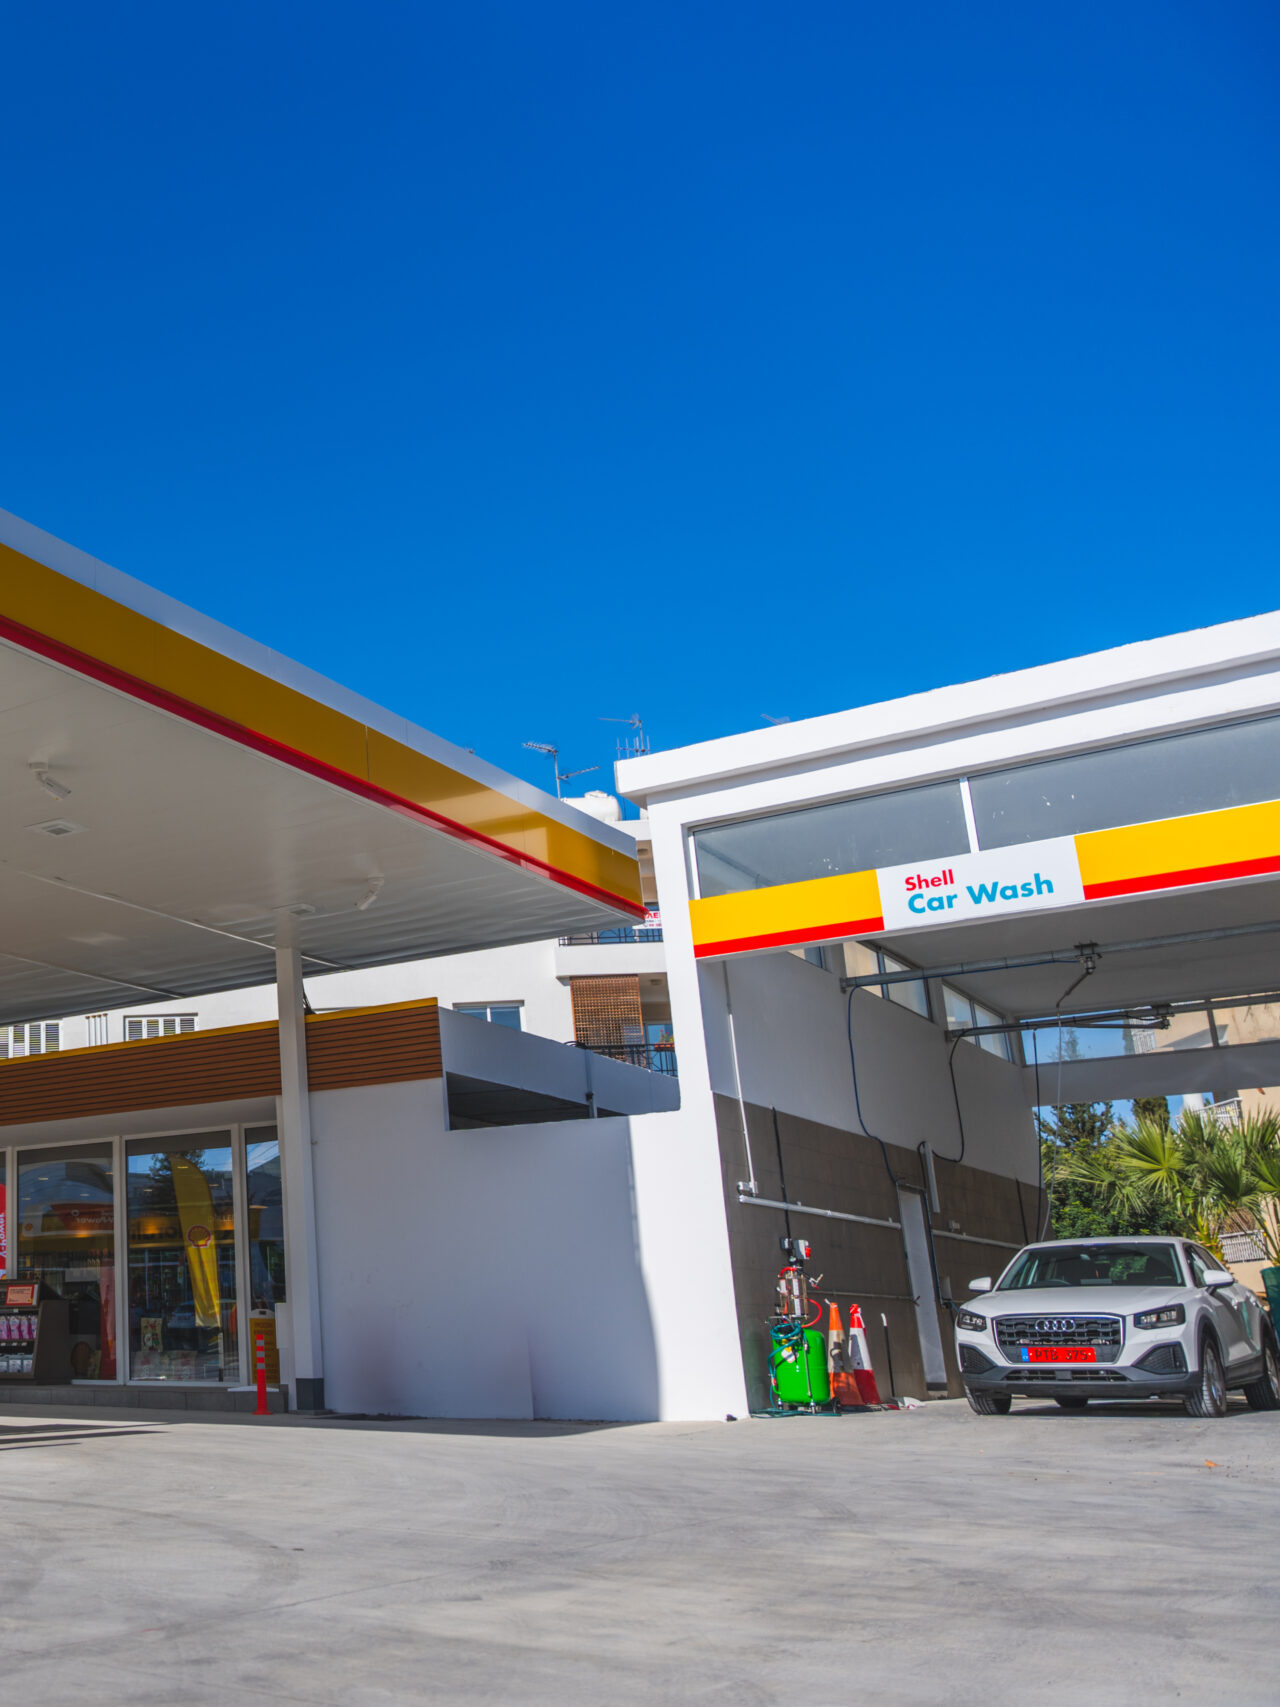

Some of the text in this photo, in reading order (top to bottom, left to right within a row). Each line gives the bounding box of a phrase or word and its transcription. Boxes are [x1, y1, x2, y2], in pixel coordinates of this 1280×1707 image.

[905, 869, 954, 891] Shell
[908, 873, 1054, 914] Car Wash
[1034, 1349, 1088, 1361] PTB 375
